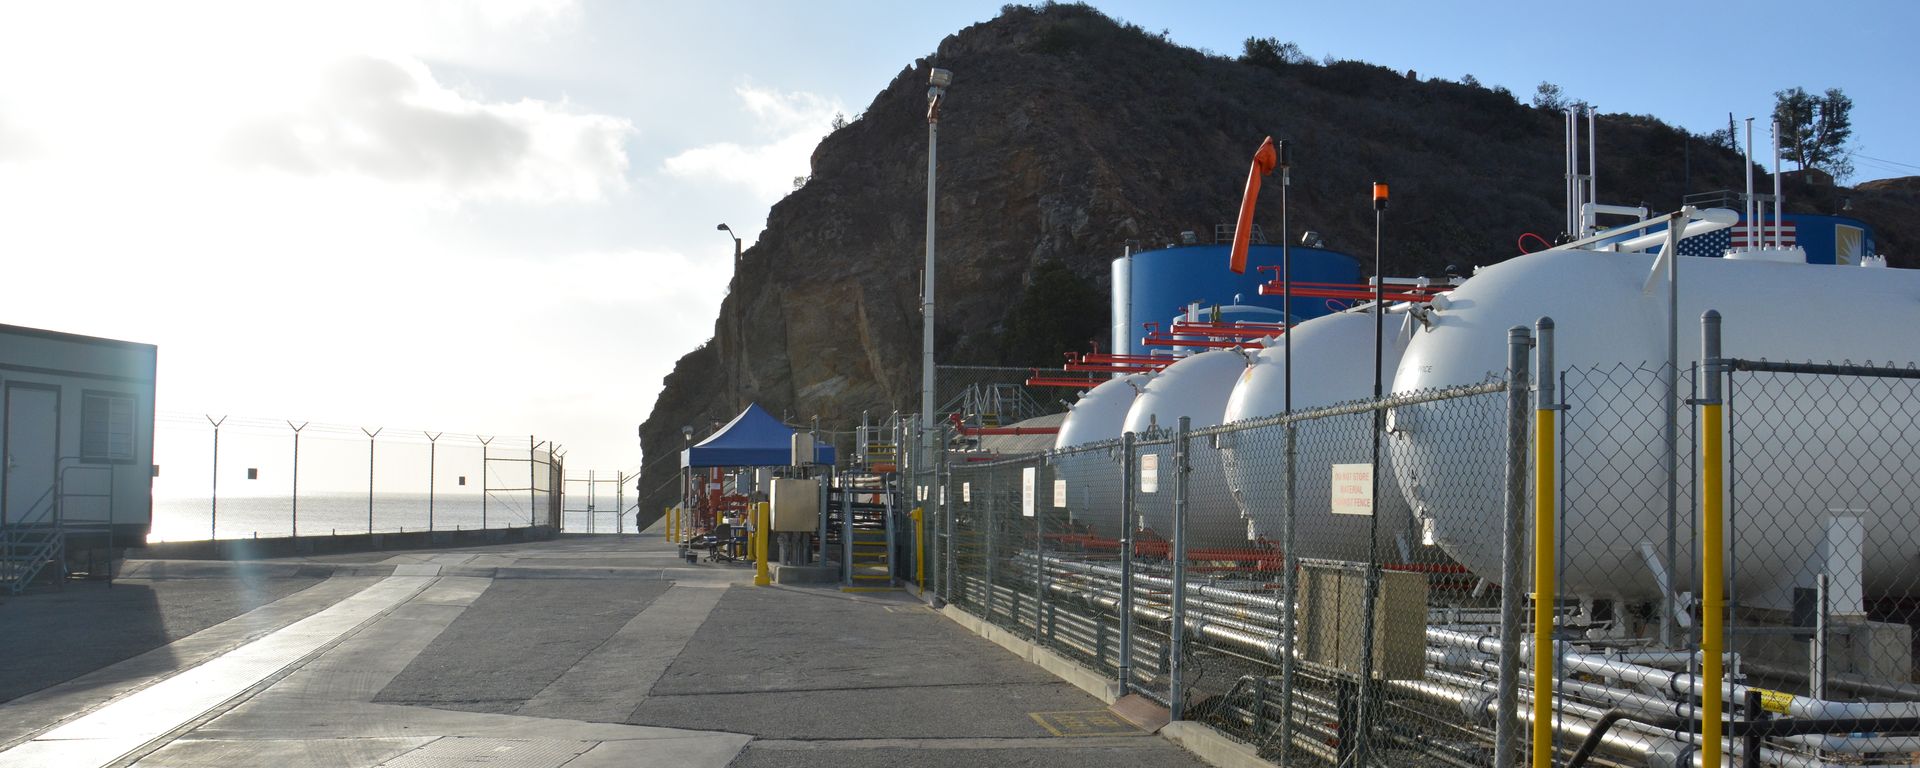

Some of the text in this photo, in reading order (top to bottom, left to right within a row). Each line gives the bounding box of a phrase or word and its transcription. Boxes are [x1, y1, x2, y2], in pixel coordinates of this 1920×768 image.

[1335, 472, 1343, 481] DO
[1352, 472, 1369, 481] STORE
[1353, 498, 1371, 508] FENCE
